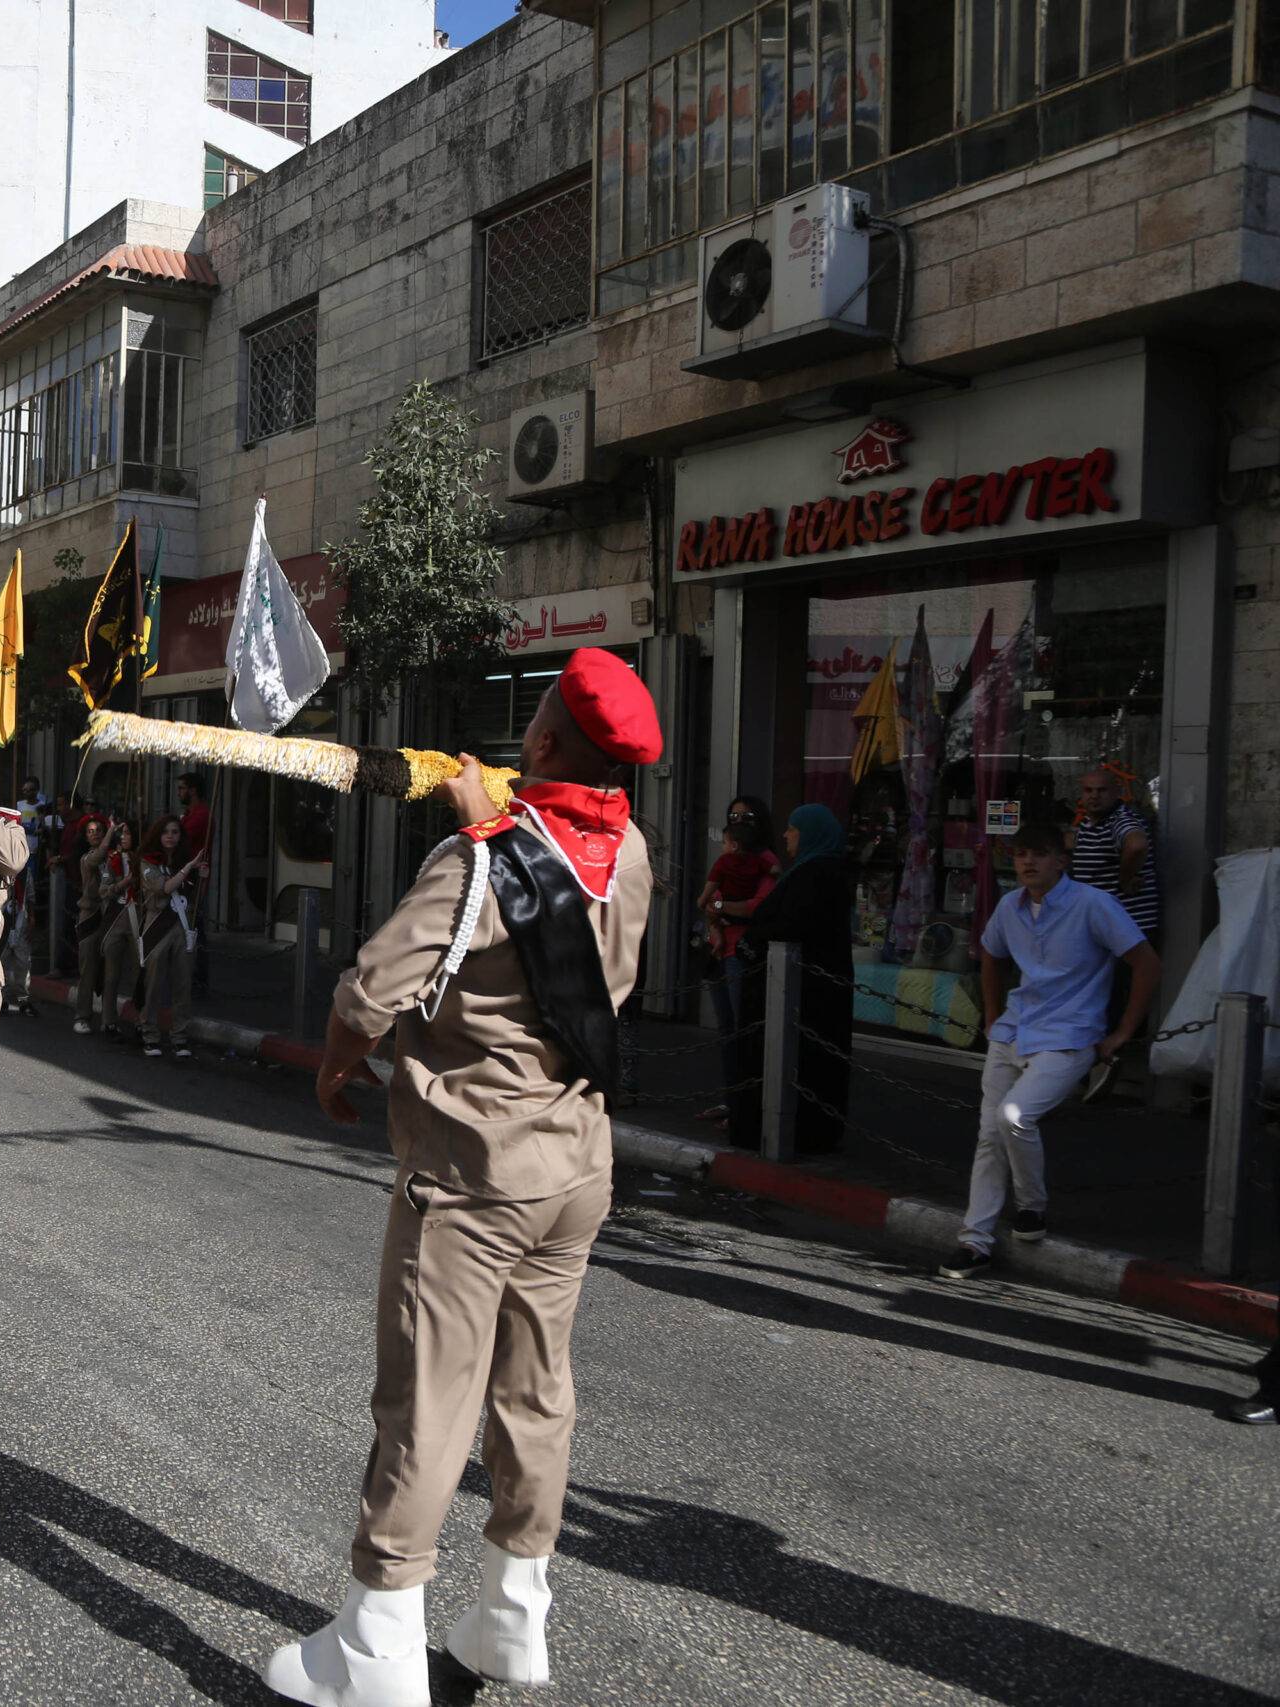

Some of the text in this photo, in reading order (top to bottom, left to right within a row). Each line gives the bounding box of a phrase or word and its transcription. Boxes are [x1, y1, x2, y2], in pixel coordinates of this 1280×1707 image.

[559, 410, 580, 423] ELCO
[676, 446, 1119, 572] RANA HOUSE CENTER
[505, 604, 608, 650] صالون
